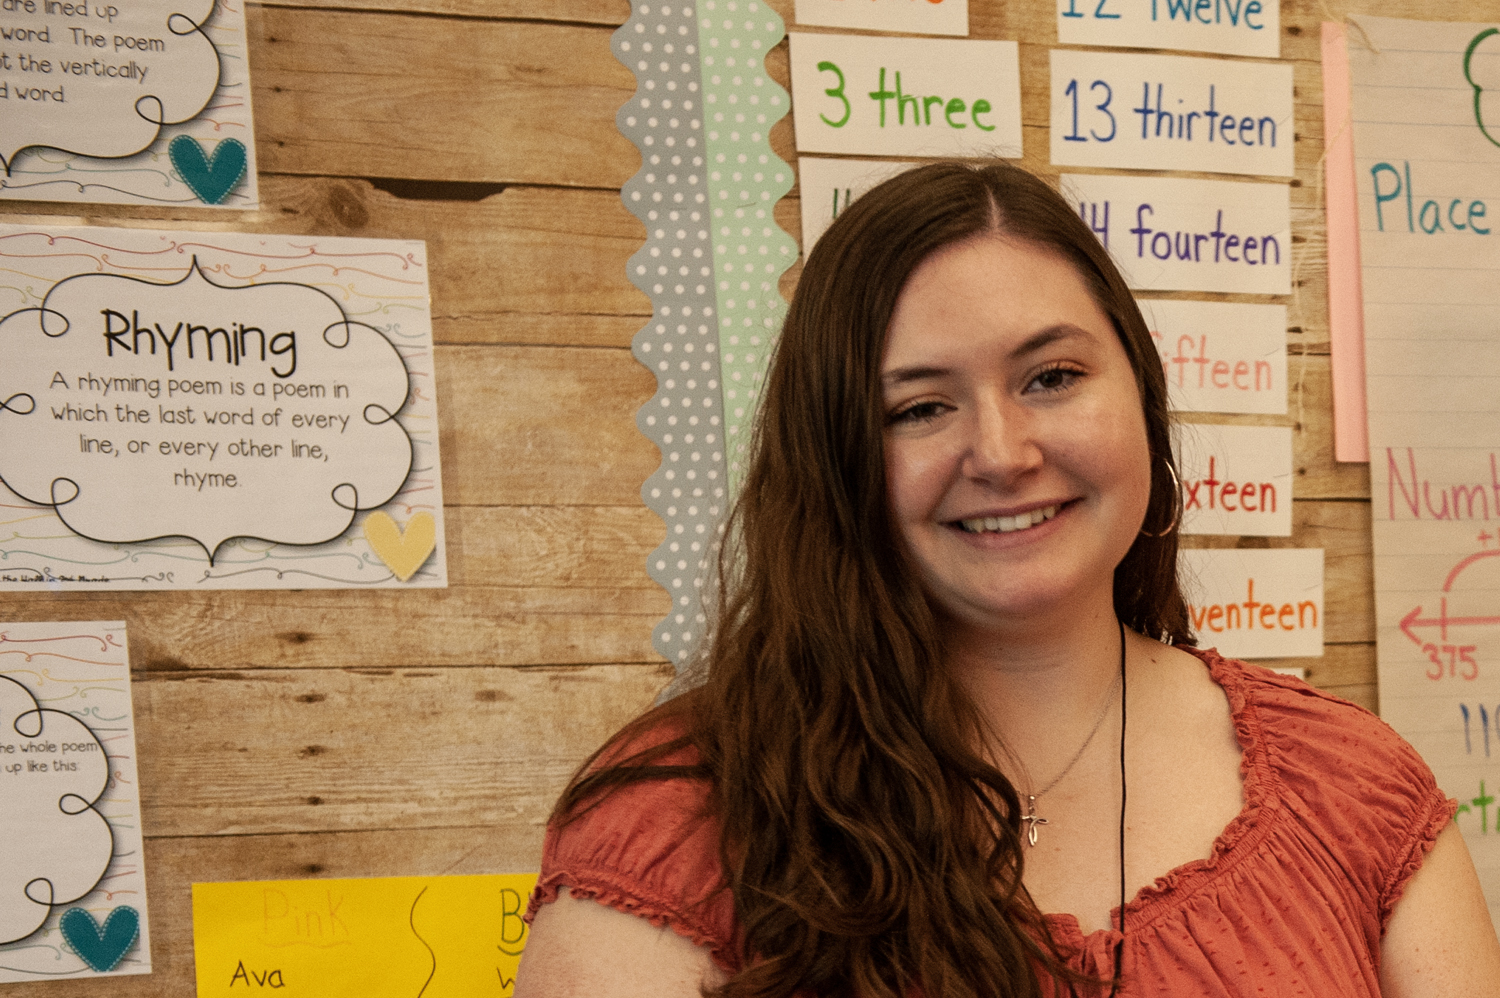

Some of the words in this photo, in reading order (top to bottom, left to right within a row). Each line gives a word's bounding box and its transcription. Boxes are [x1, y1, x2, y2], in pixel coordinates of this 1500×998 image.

[95, 5, 118, 23] up
[68, 27, 106, 48] The
[114, 35, 165, 52] poem
[18, 53, 52, 73] the
[60, 58, 148, 84] vertically
[817, 60, 852, 129] 3
[868, 67, 997, 132] three
[1062, 79, 1117, 143] 13
[1134, 82, 1277, 148] thirteen
[1370, 161, 1491, 235] Place
[1130, 204, 1281, 266] fourteen
[101, 308, 297, 378] Rhyming
[49, 371, 70, 390] A
[78, 372, 161, 398] rhyming
[168, 376, 222, 396] poem
[230, 378, 246, 396] is
[253, 383, 266, 397] a
[272, 379, 326, 401] poem
[333, 382, 349, 398] in
[50, 404, 108, 423] which
[115, 404, 151, 424] the
[159, 405, 196, 425] last
[204, 406, 254, 426] word
[261, 407, 282, 427] of
[292, 412, 350, 433] every
[79, 434, 120, 457] line,
[127, 439, 150, 455] or
[159, 439, 219, 461] every
[227, 438, 283, 458] other
[292, 439, 329, 462] line,
[1423, 645, 1478, 681] 375
[20, 740, 57, 753] whole
[61, 742, 98, 755] poem
[5, 762, 22, 775] up
[27, 760, 48, 772] like
[230, 959, 285, 989] Ava
